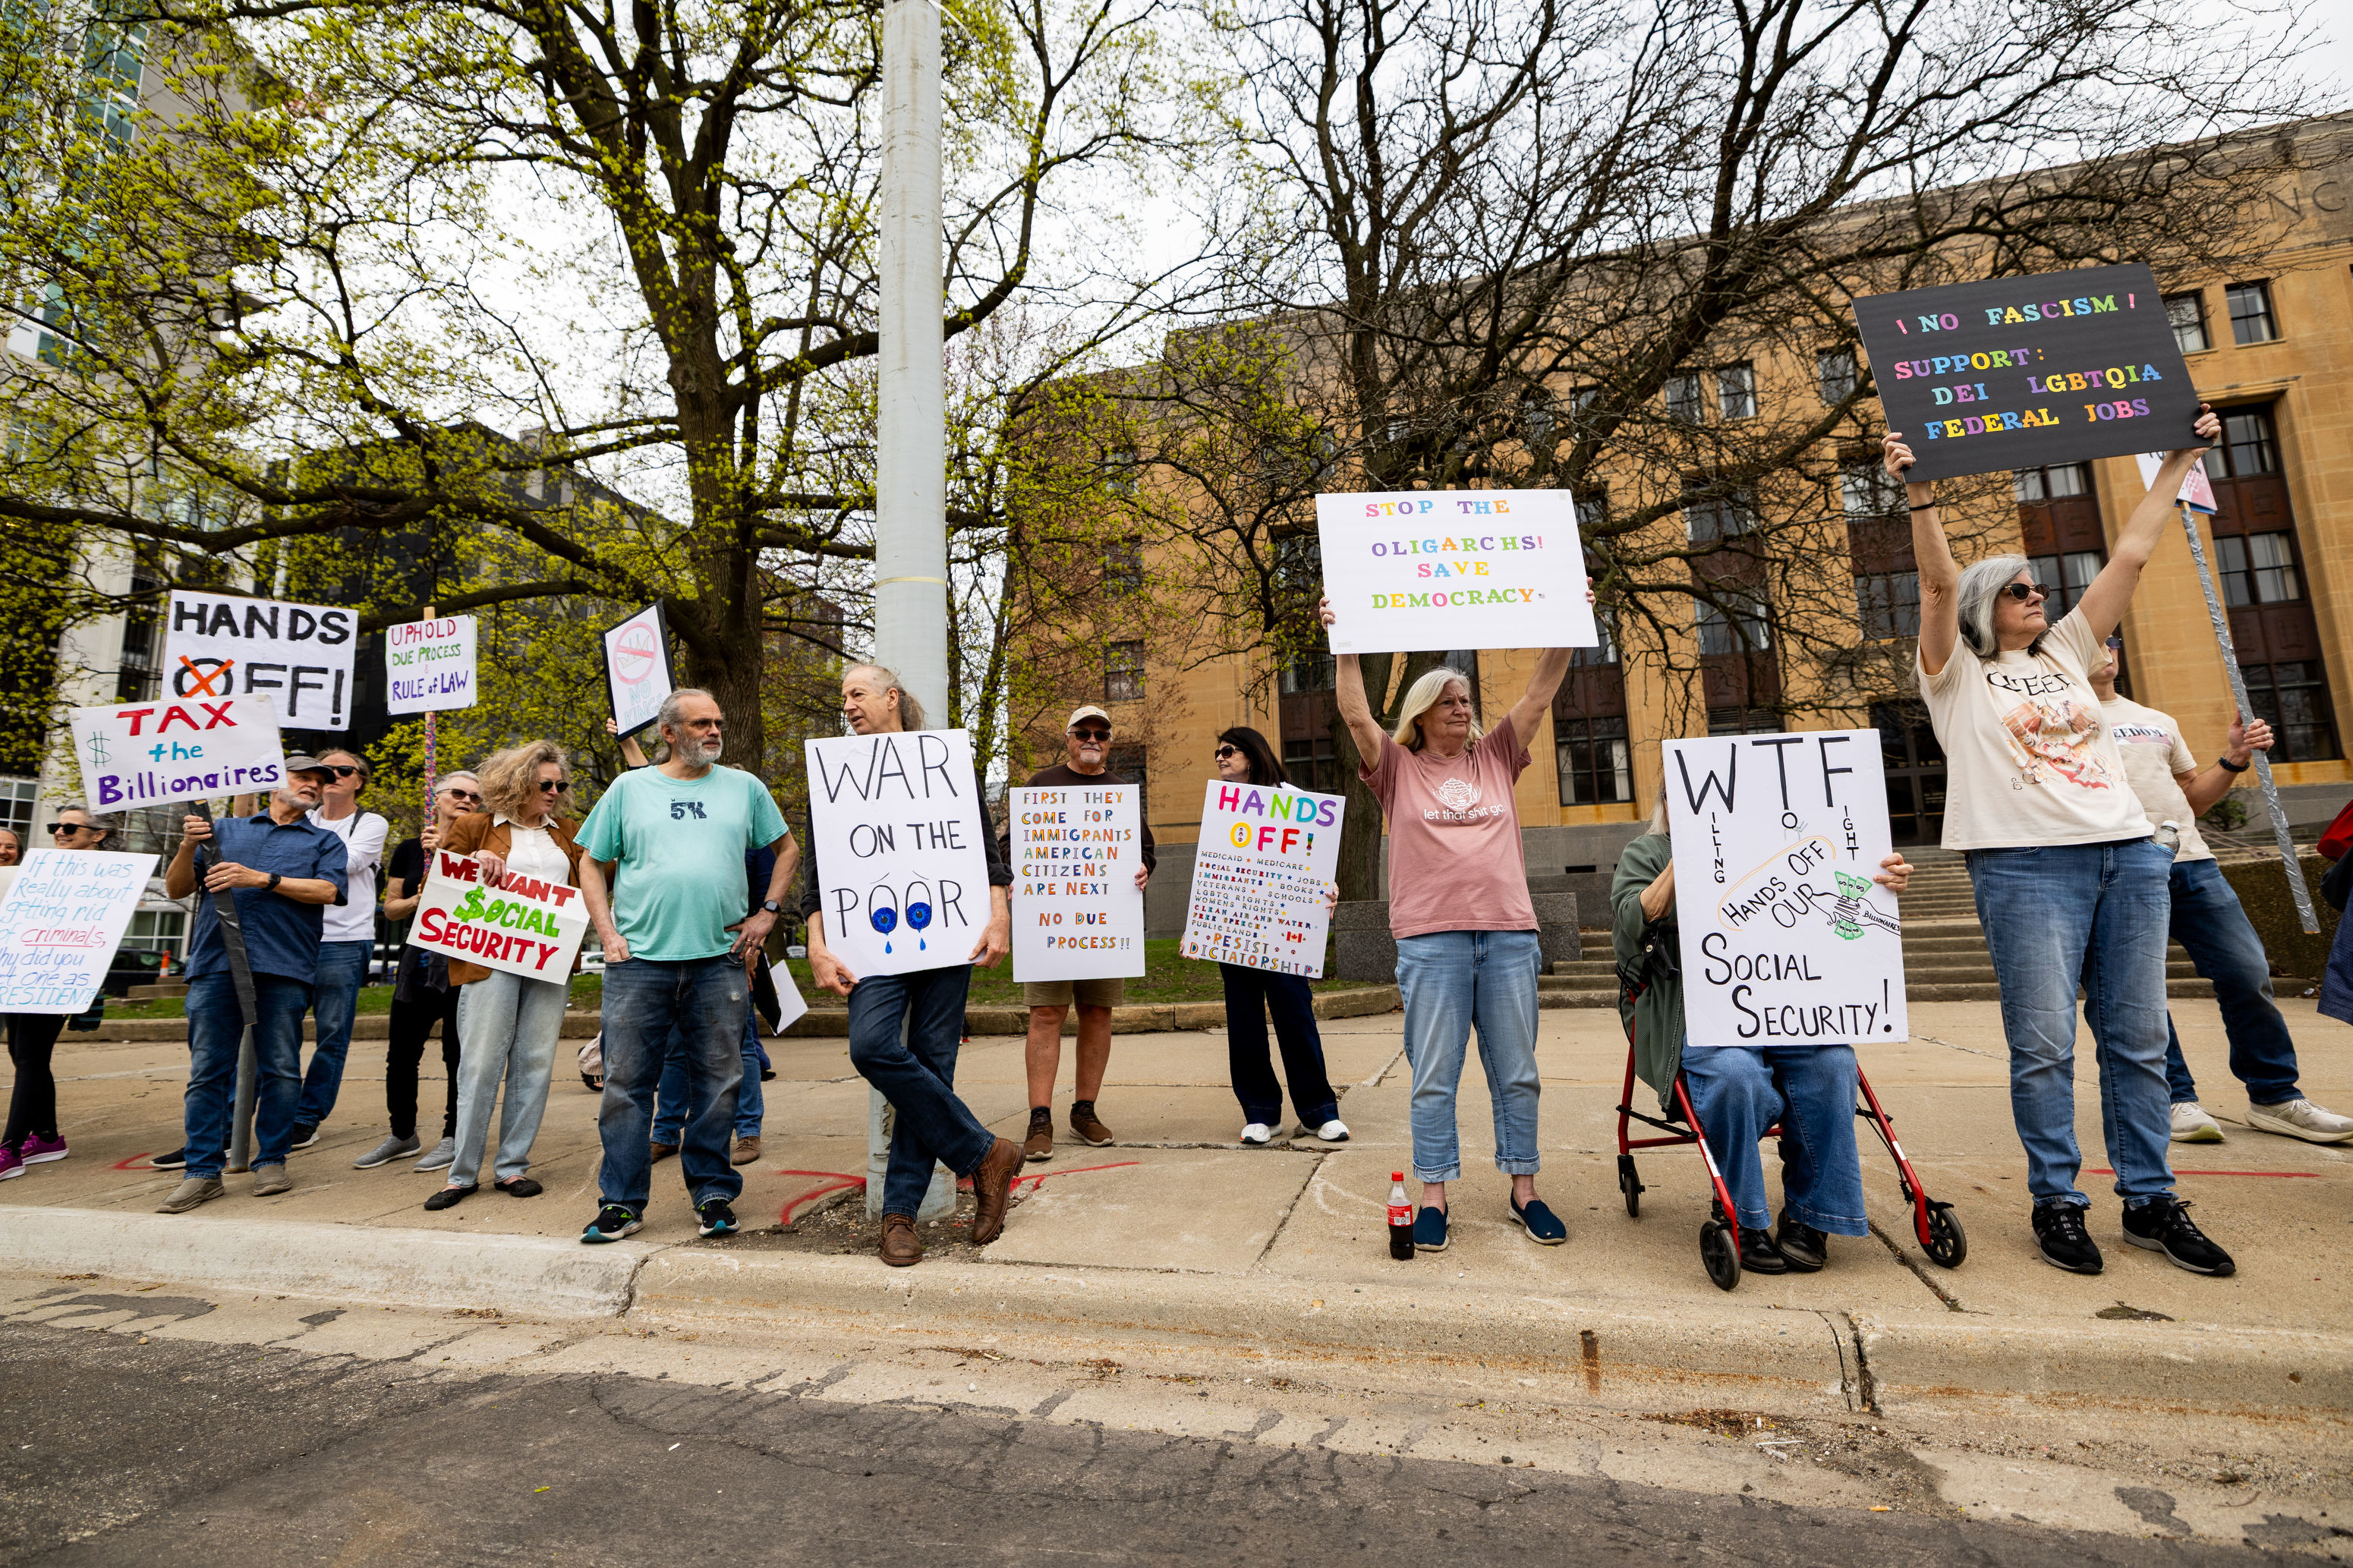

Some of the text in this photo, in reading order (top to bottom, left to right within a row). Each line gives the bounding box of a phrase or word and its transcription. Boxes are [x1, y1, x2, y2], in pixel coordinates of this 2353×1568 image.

[1918, 313, 1959, 333] NO
[1985, 294, 2118, 326] FASCISM
[1931, 364, 2162, 405] DEI LGBTQIA
[1924, 398, 2151, 440] FEDERAL JOBS
[1365, 499, 1510, 518] STOP THE
[1371, 535, 1543, 557] OLIGARCHS!
[1417, 561, 1489, 578] SAVE
[1371, 588, 1535, 609] DEMOCRACY
[173, 600, 350, 645] HANDS
[391, 619, 456, 646] UPHOLD
[392, 643, 461, 666] DUE PROCESS
[172, 654, 345, 726] OFF!
[392, 669, 468, 701] RULE of LAW
[628, 679, 651, 707] NO
[116, 701, 238, 736] TAX
[2112, 728, 2164, 738] EEDOM
[148, 741, 204, 763] the
[815, 734, 958, 803] WAR
[1674, 736, 1853, 815] WTF
[98, 764, 279, 805] Billionaires
[670, 801, 707, 820] 5K
[1023, 792, 1123, 804] FIRST THEY
[1218, 785, 1337, 827] HANDS
[1022, 809, 1114, 825] COME FOR
[1424, 808, 1440, 820] let
[1442, 809, 1466, 820] that
[1468, 806, 1488, 819] shit
[849, 820, 967, 858] ON THE
[1023, 828, 1132, 842] IMMIGRANTS
[1230, 821, 1315, 857] OFF!
[29, 852, 134, 879] If this was
[1023, 846, 1118, 860] AMERICAN
[439, 852, 480, 883] WE
[1022, 863, 1107, 877] CITIZENS
[1199, 861, 1321, 886] SOCIAL SECURITY JOBS
[13, 877, 133, 905] Really about
[1024, 882, 1110, 896] ARE NEXT
[1196, 889, 1229, 899] LGBTQ
[1197, 880, 1313, 904] VETERANS SCHOOLS
[1199, 871, 1314, 895] IMMIGRANTS BOOKS
[1721, 839, 1825, 927] HANDS OFF
[0, 897, 110, 927] getting rid
[830, 880, 968, 938] POOR
[1195, 895, 1234, 908] WOMENS
[1039, 912, 1107, 926] NO DUE
[1192, 912, 1260, 930] FREE SPEECH
[1194, 904, 1311, 930] CLEAN AIR AND WATER
[1862, 910, 1901, 932] BILLIONAIRES
[0, 922, 106, 948] of criminals,
[418, 907, 559, 971] SECURITY
[1047, 936, 1130, 949] PROCESS!!
[1213, 932, 1269, 955] RESIST
[1226, 926, 1258, 938] LANDS
[0, 946, 85, 974] hy did you
[1189, 941, 1313, 977] DICTATORSHIP
[1701, 932, 1822, 985] SOCIAL
[20, 970, 59, 986] one
[62, 973, 91, 986] as
[0, 986, 97, 1006] RESIDENT?
